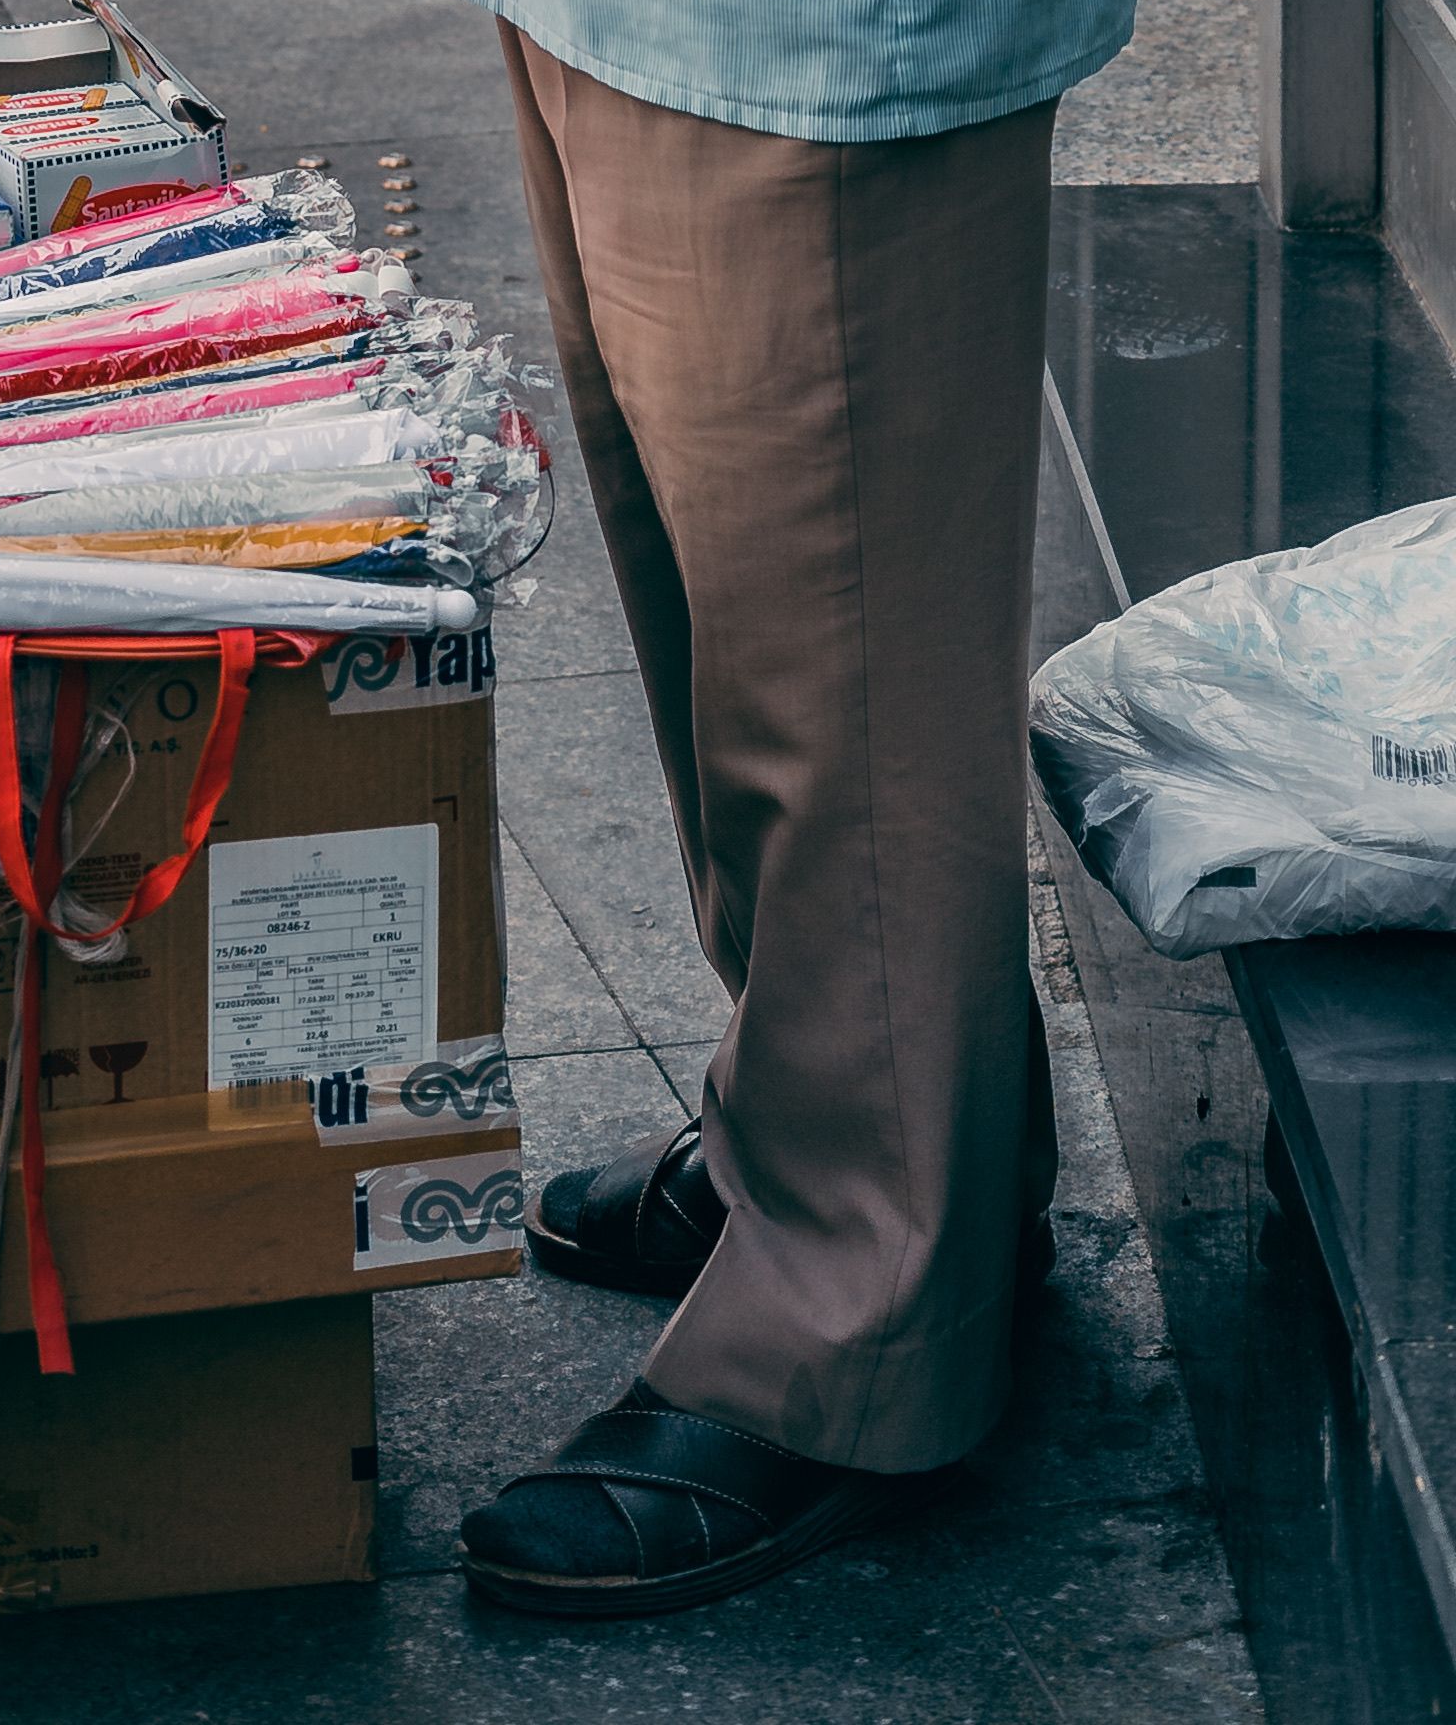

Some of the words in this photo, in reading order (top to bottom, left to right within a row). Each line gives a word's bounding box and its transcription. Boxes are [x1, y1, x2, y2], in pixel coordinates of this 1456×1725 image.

[372, 931, 402, 943] EKRU
[245, 1037, 252, 1046] 6
[308, 1067, 369, 1128] di
